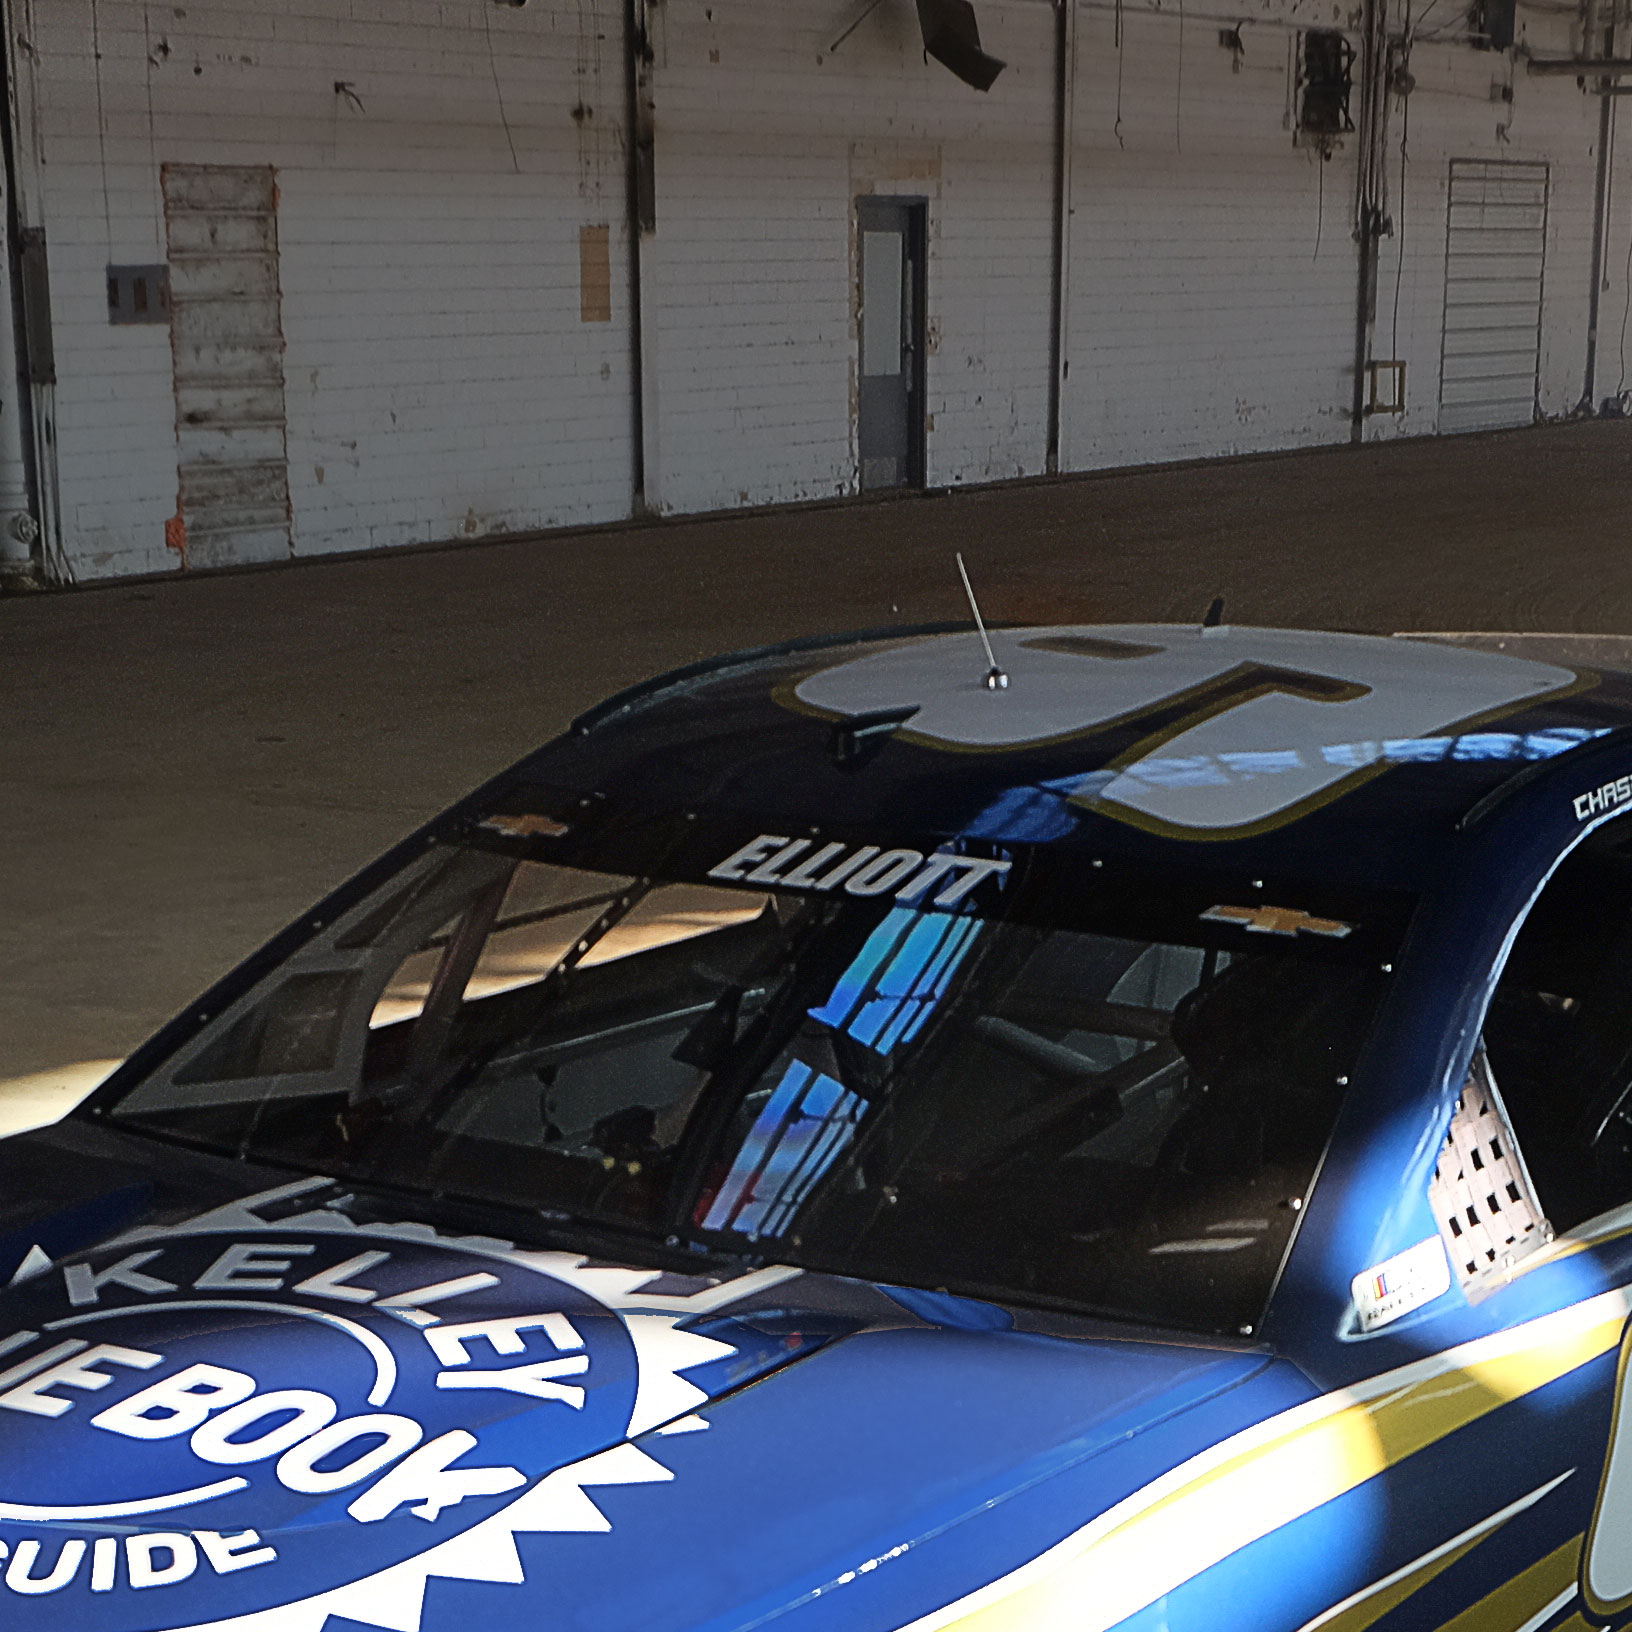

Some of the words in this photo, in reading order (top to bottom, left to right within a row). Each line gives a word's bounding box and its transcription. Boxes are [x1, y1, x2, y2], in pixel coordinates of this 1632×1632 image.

[706, 834, 1013, 907] ELLIOTT
[62, 1242, 591, 1412] KELLEY
[90, 1363, 528, 1524] BOOK
